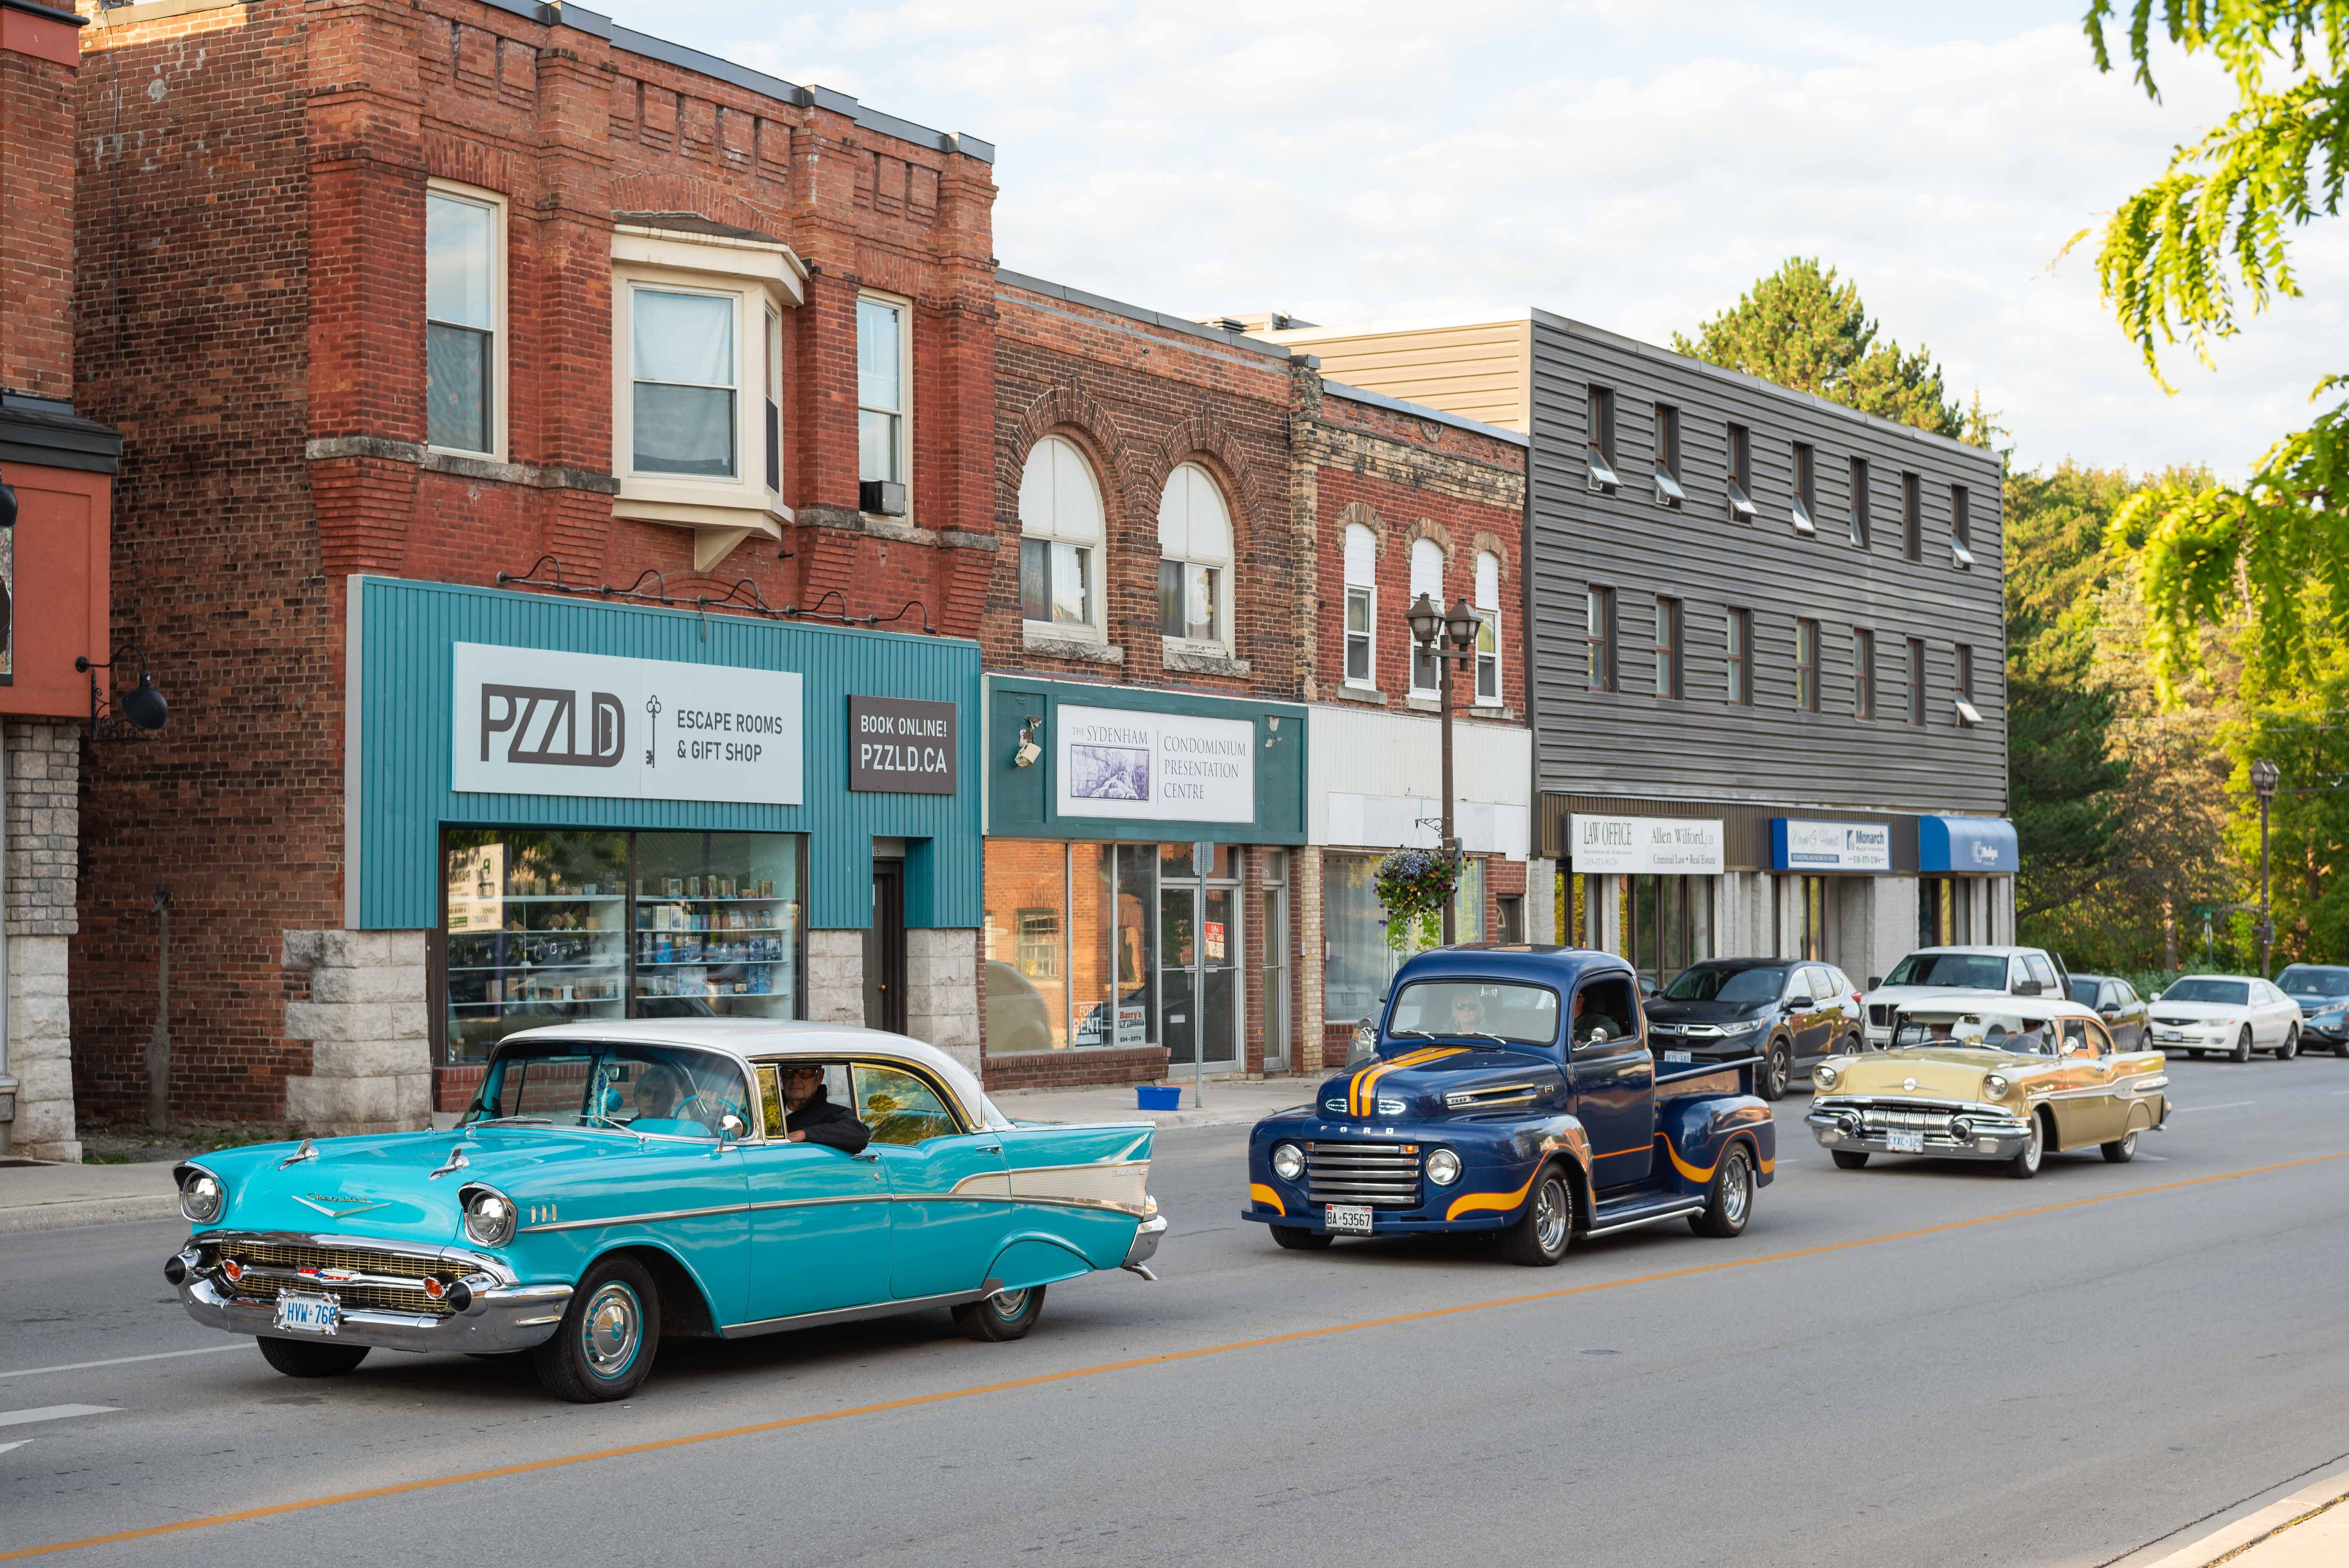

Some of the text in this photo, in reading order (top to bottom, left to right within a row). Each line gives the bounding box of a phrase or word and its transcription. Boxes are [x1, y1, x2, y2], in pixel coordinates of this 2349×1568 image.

[677, 710, 782, 734] ESCAPE ROOMS
[861, 715, 947, 737] BOOK ONLINE!
[1073, 726, 1148, 745] THE SYDENHAM
[677, 740, 762, 762] & GIFT SHOP
[1164, 736, 1246, 756] CONDOMINIUM
[861, 744, 947, 773] PZZLD.CA
[1165, 759, 1239, 778] PRESENTATION
[1164, 783, 1204, 799] CENTRE
[1584, 821, 1632, 845] LAW OFFICE
[1651, 827, 1672, 844] Allen
[1856, 830, 1884, 845] Monarch
[1653, 853, 1716, 864] Criminal Law Real Estate
[1079, 1006, 1094, 1016] FOR
[1119, 1010, 1142, 1019] Barry's
[1073, 1017, 1101, 1034] RENT
[1320, 1126, 1394, 1135] FORD
[307, 1192, 372, 1203] Chevrolet
[1327, 1212, 1370, 1226] BA 53567
[287, 1302, 308, 1323] HVW
[315, 1304, 336, 1325] 768
